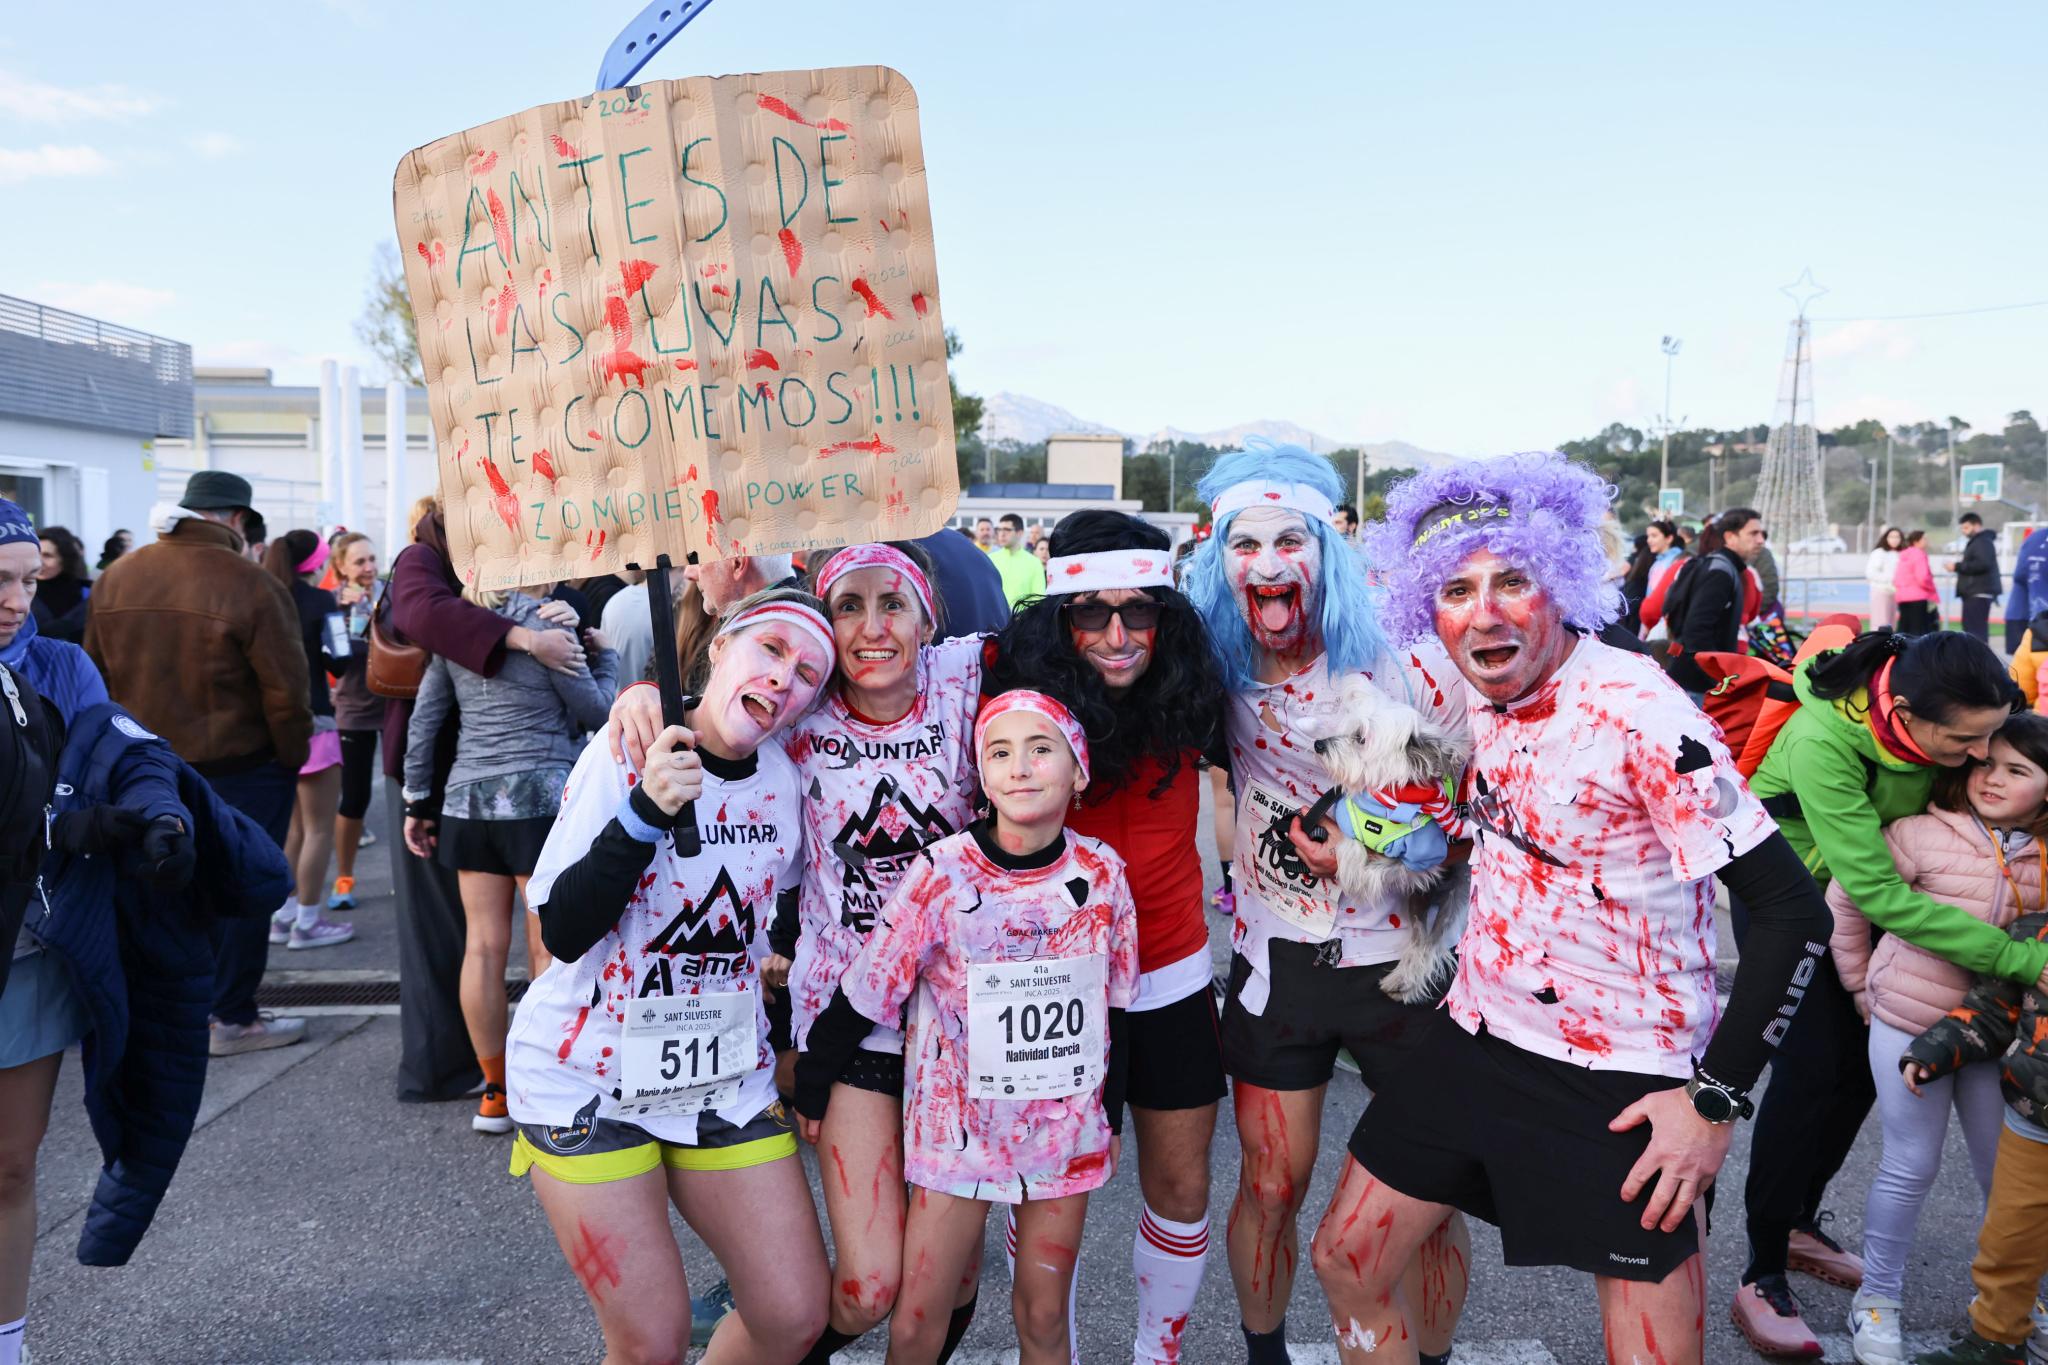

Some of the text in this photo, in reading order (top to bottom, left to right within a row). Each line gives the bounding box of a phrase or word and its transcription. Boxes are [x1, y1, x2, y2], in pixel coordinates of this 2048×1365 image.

[598, 92, 652, 118] 2026
[456, 134, 859, 289] ANTES DE
[868, 263, 906, 286] 2026
[465, 291, 584, 385] LAS
[474, 363, 921, 466] TE COMEMOS!!!
[888, 452, 922, 473] 2026
[529, 473, 864, 541] ZOMBIES POWER
[1252, 790, 1270, 808] 38a
[1006, 927, 1060, 938] GOAL MAKER
[1033, 965, 1050, 975] 41a
[1010, 973, 1072, 989] SANT SILVESTRE
[1024, 988, 1042, 998] INCA
[1043, 987, 1061, 998] 2025
[685, 999, 701, 1008] 41a
[664, 1009, 722, 1023] SANT SILVESTRE
[998, 998, 1085, 1045] 1020
[676, 1024, 694, 1032] INCA
[695, 1022, 712, 1031] 2025
[659, 1035, 719, 1081] 511
[1005, 1046, 1050, 1063] Natividad
